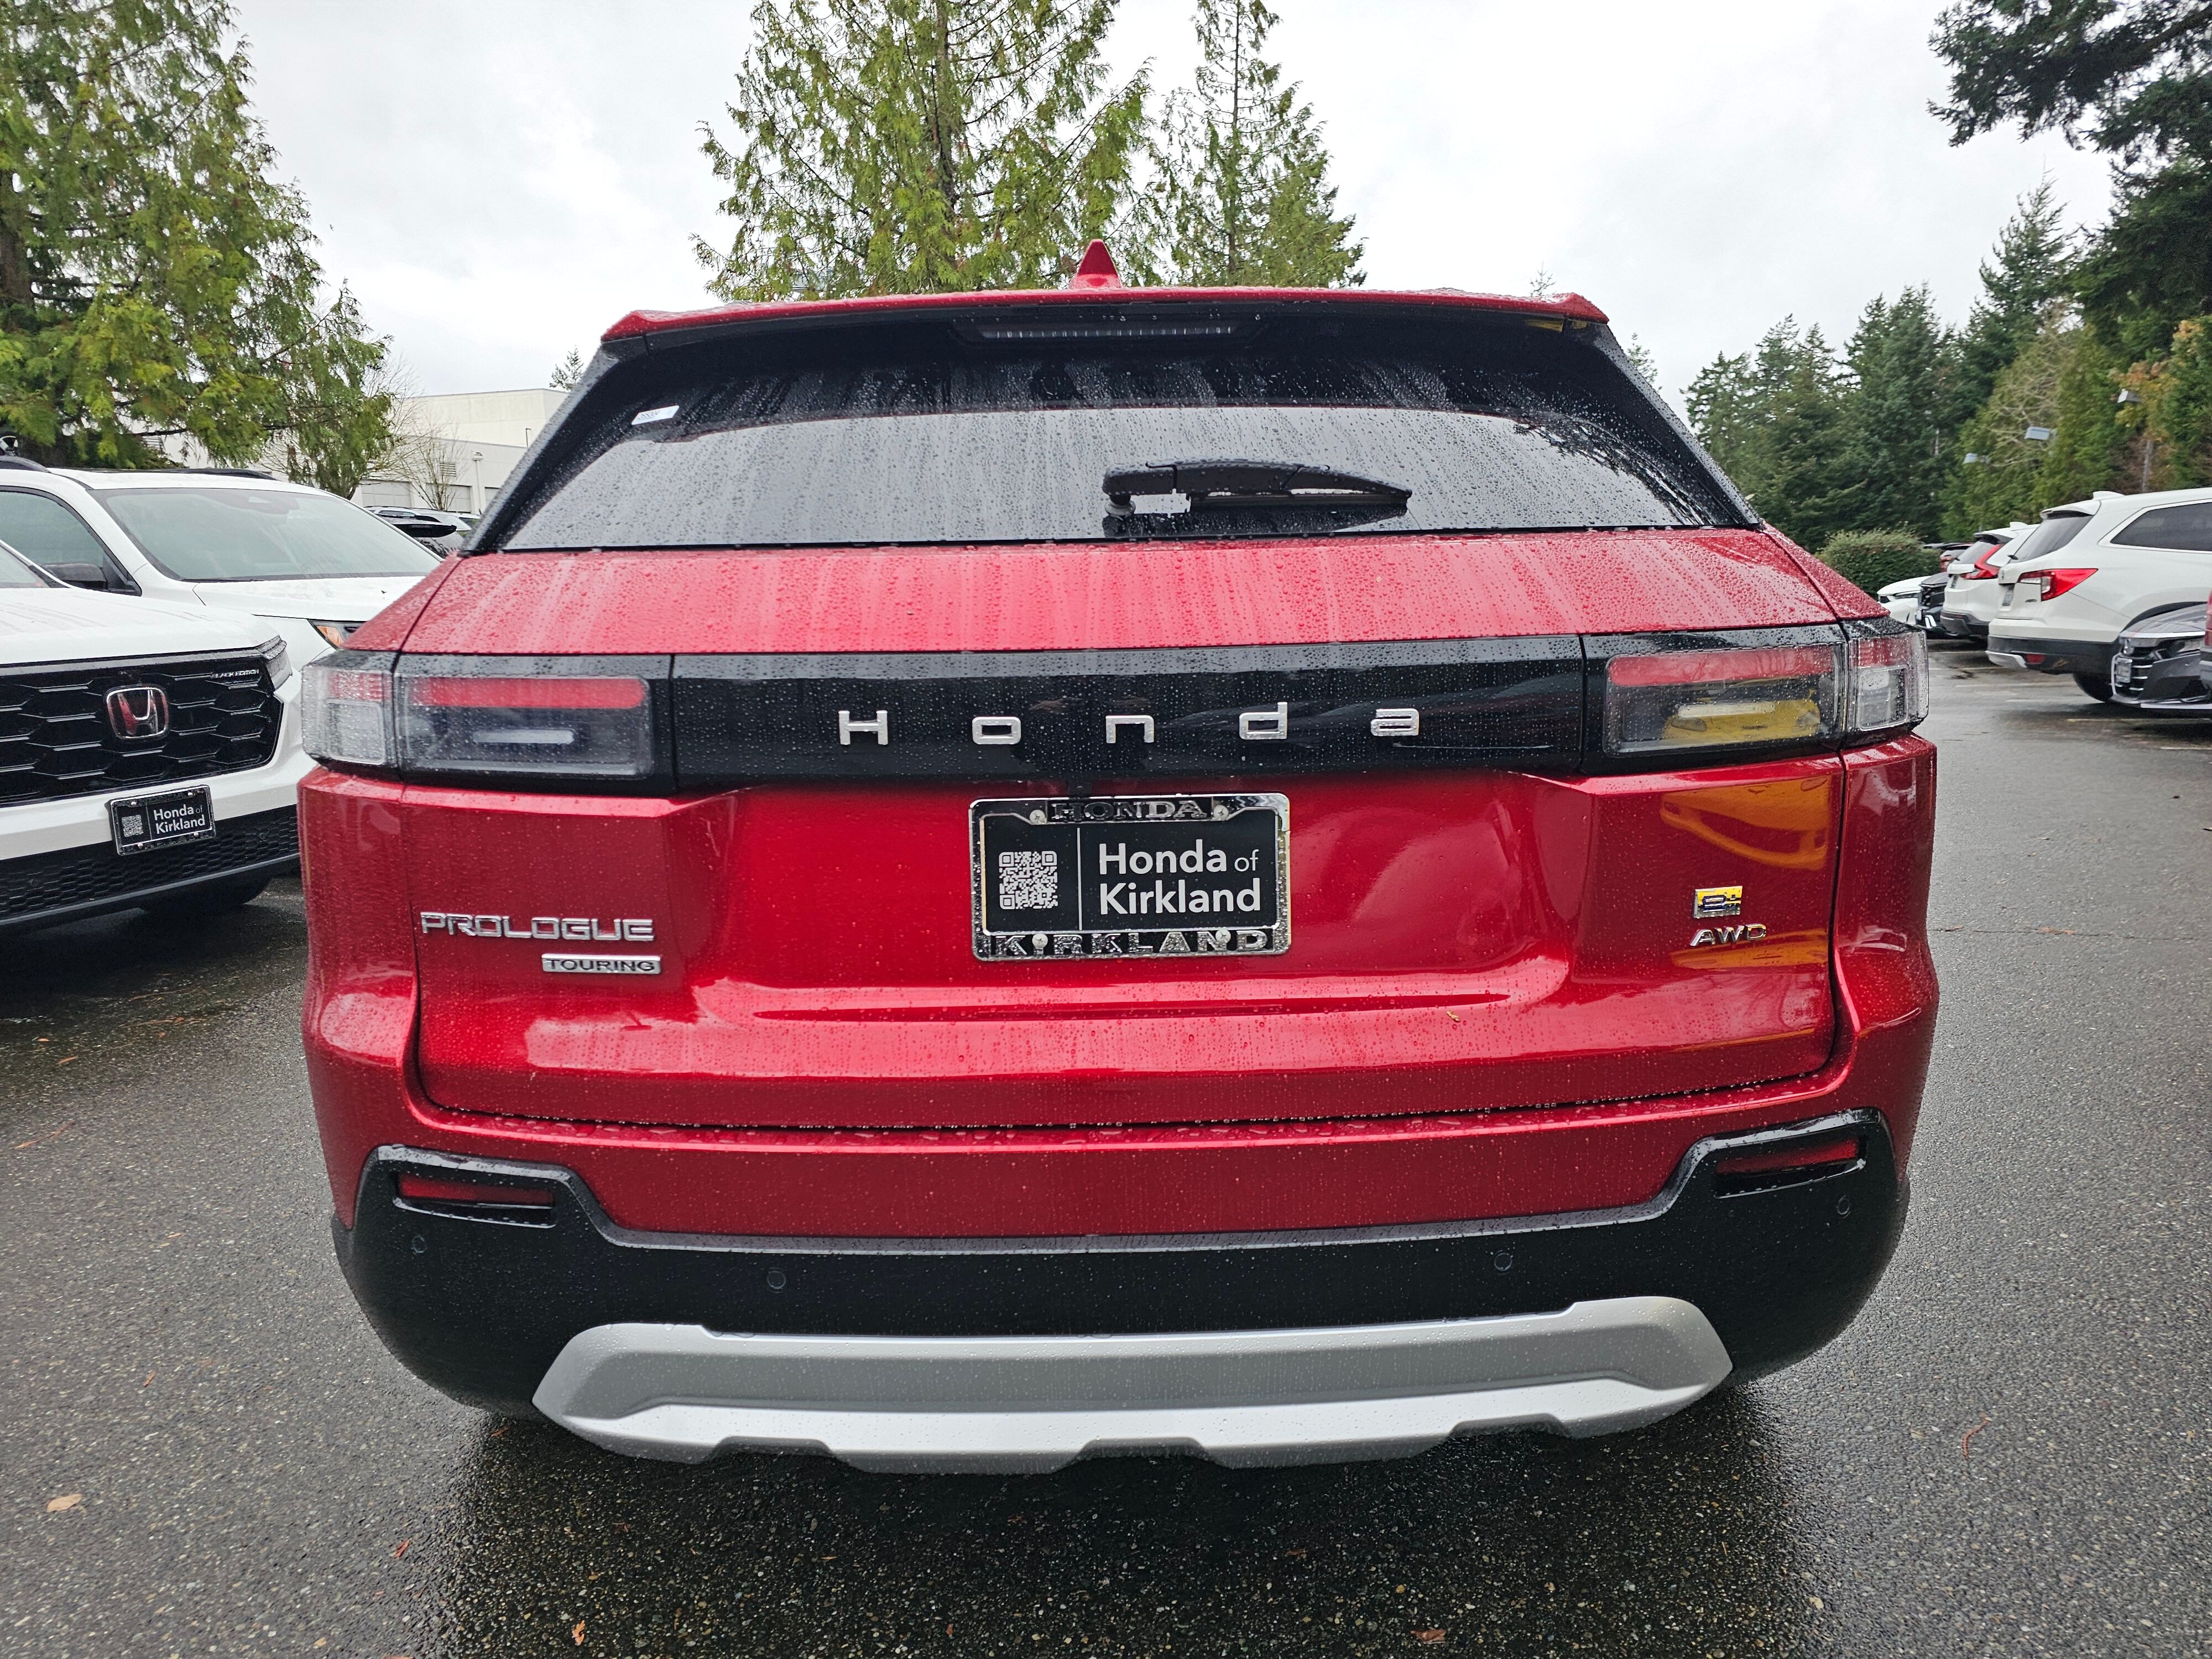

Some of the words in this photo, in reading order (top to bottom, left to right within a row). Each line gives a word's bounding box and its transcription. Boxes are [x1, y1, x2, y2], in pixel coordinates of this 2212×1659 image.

[153, 804, 194, 821] Honda
[195, 805, 203, 814] of
[1051, 800, 1208, 822] HONDA
[155, 815, 206, 834] Kirkland
[1099, 839, 1227, 875] Honda
[1234, 849, 1259, 872] of
[1099, 878, 1261, 915] Kirkland
[420, 912, 654, 941] PROLOGUE
[1689, 923, 1766, 946] AWD
[544, 958, 655, 972] TOURING
